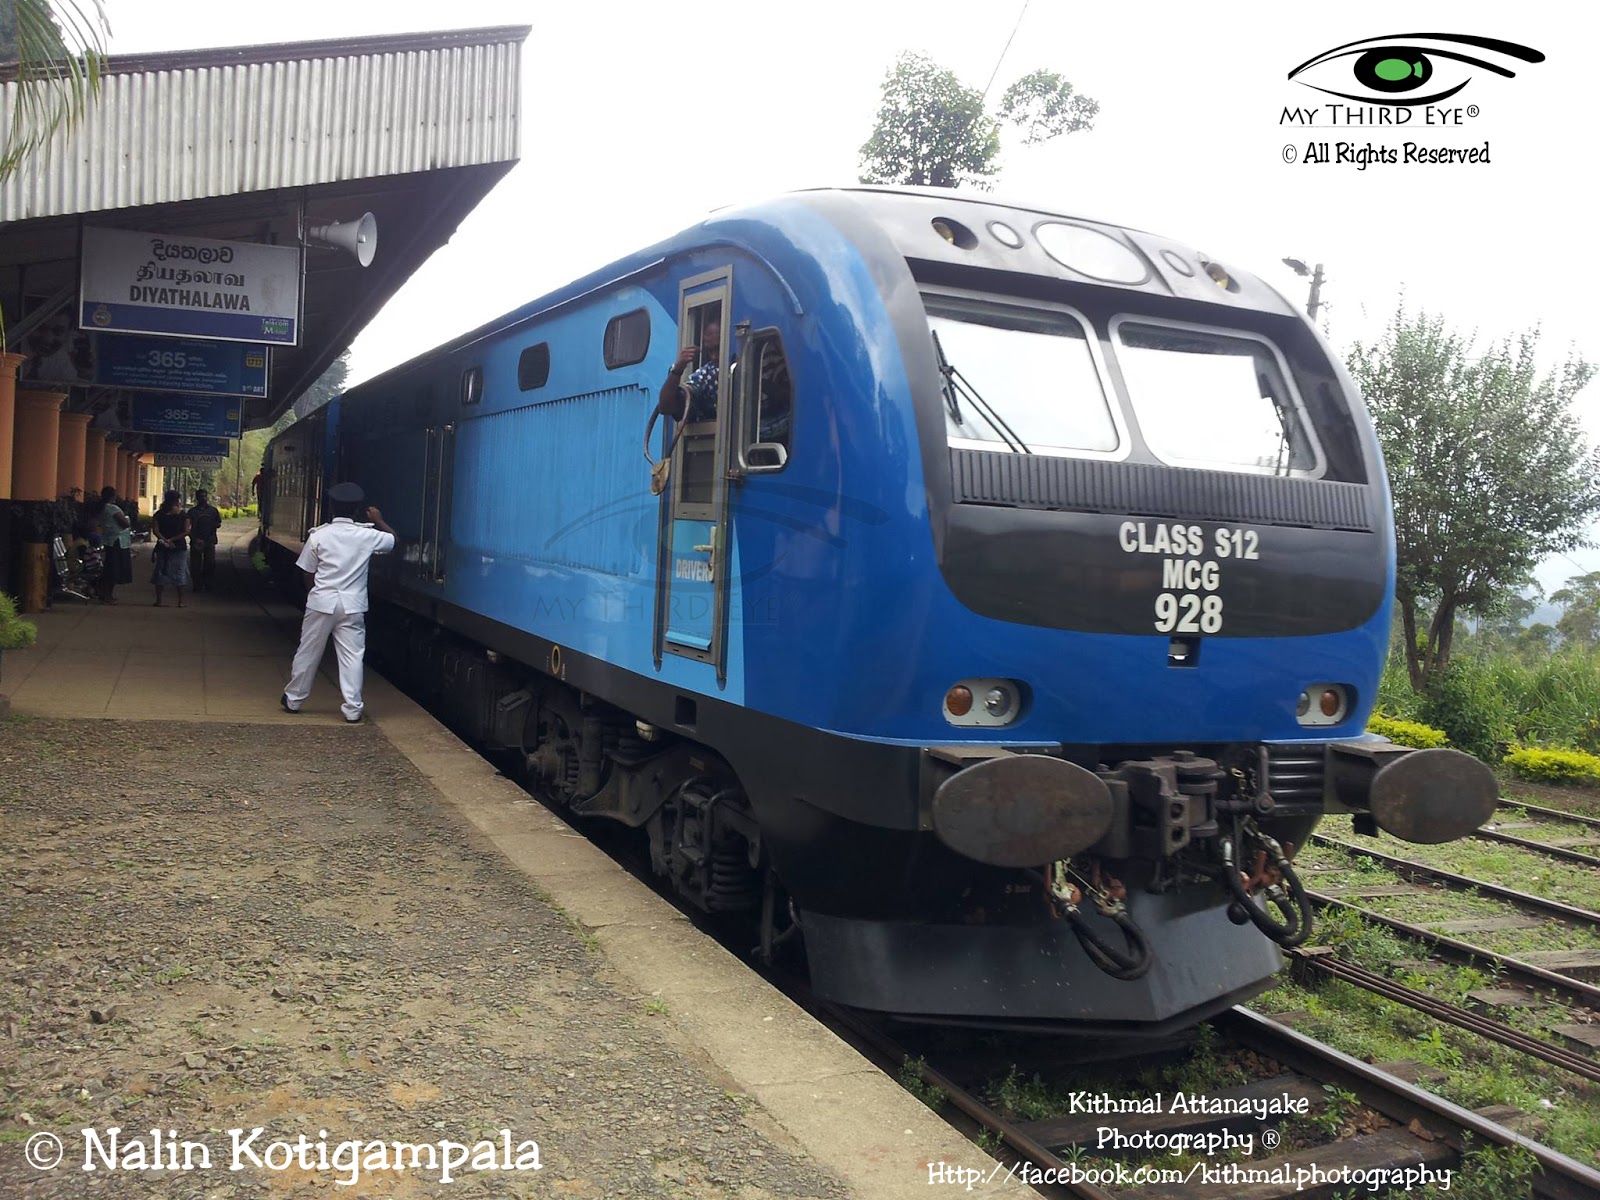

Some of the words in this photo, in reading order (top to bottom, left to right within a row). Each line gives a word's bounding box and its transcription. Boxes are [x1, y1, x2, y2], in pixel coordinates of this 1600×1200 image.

[136, 261, 245, 287] தியதலாவ
[129, 285, 250, 311] DIYATHALAWA
[147, 350, 187, 369] 365
[164, 408, 190, 420] 365
[1119, 521, 1204, 556] CLASS
[1215, 527, 1260, 560] S12
[1162, 558, 1220, 591] MCG
[1154, 592, 1223, 634] 928
